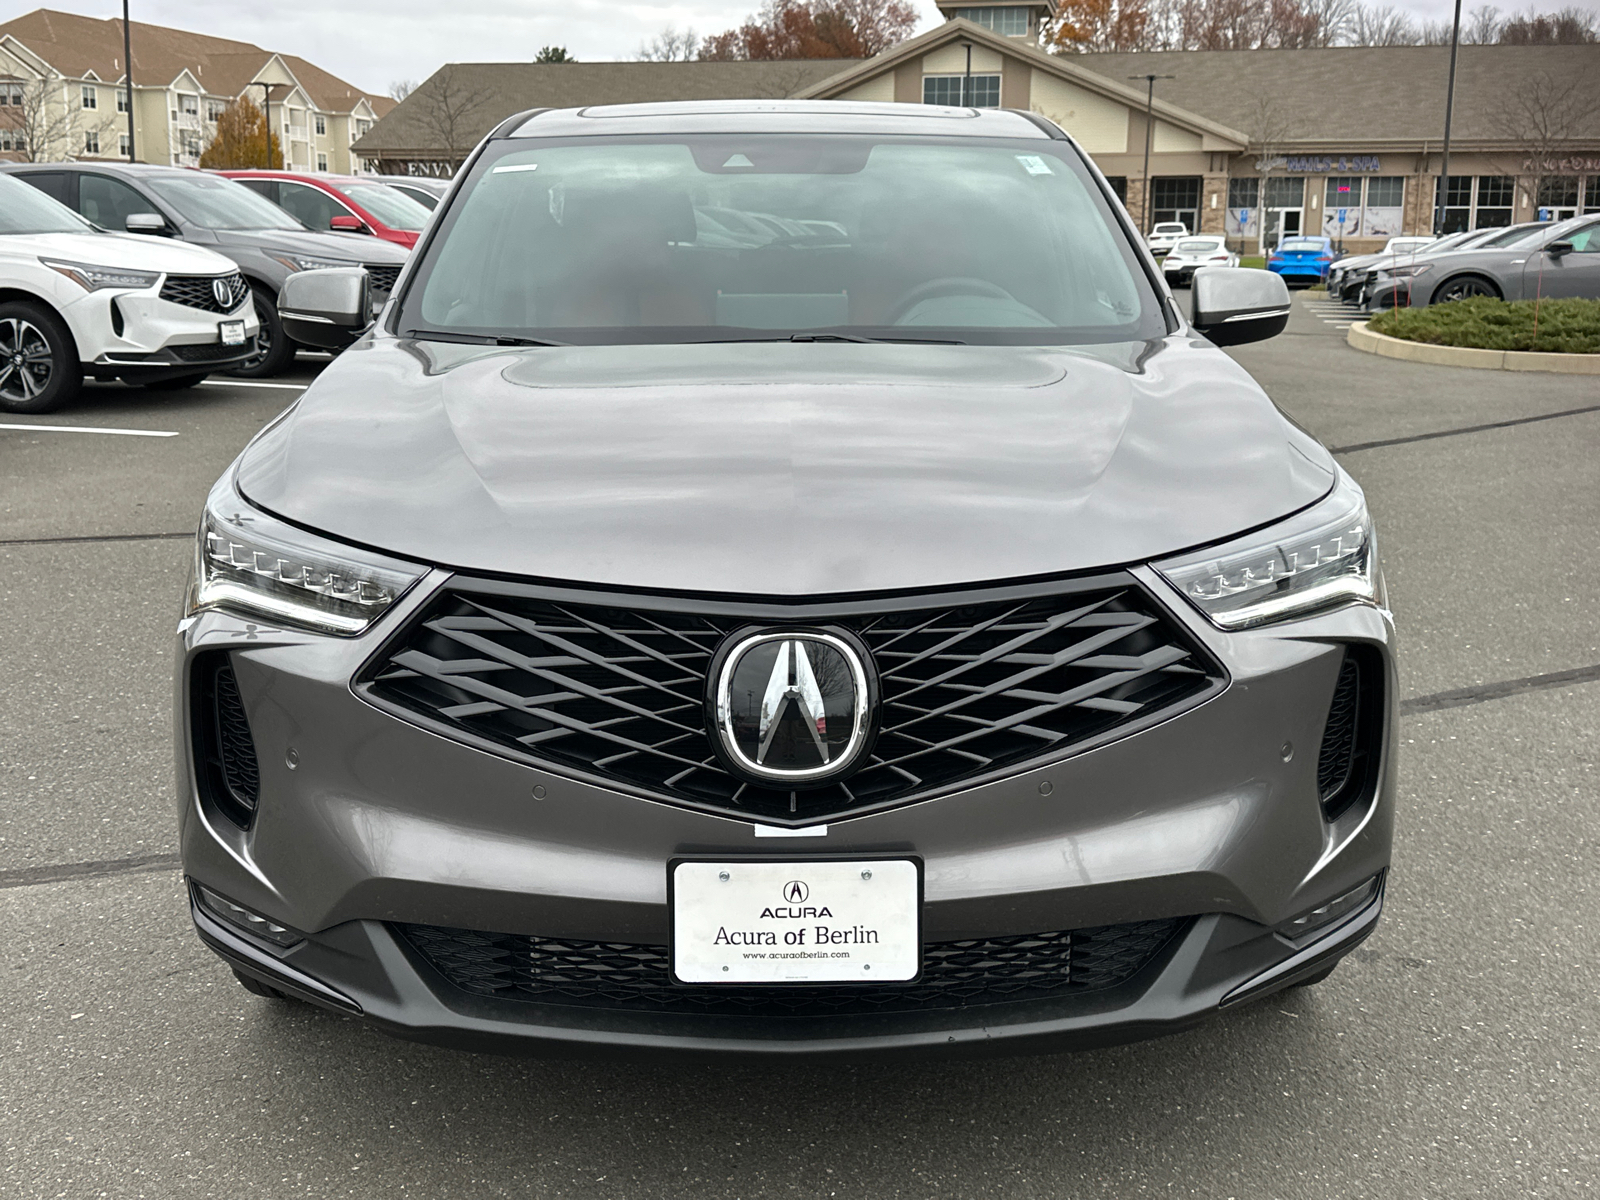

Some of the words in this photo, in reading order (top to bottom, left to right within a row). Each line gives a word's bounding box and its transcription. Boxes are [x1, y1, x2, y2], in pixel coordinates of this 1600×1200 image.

[407, 161, 454, 177] ENVY
[1287, 156, 1331, 171] NAILS
[1351, 156, 1380, 171] SPA
[759, 906, 833, 919] ACURA
[713, 926, 777, 946] Acura
[784, 928, 806, 945] of
[814, 925, 880, 945] Berlin
[742, 951, 850, 960] www.acuraofberlin.com
